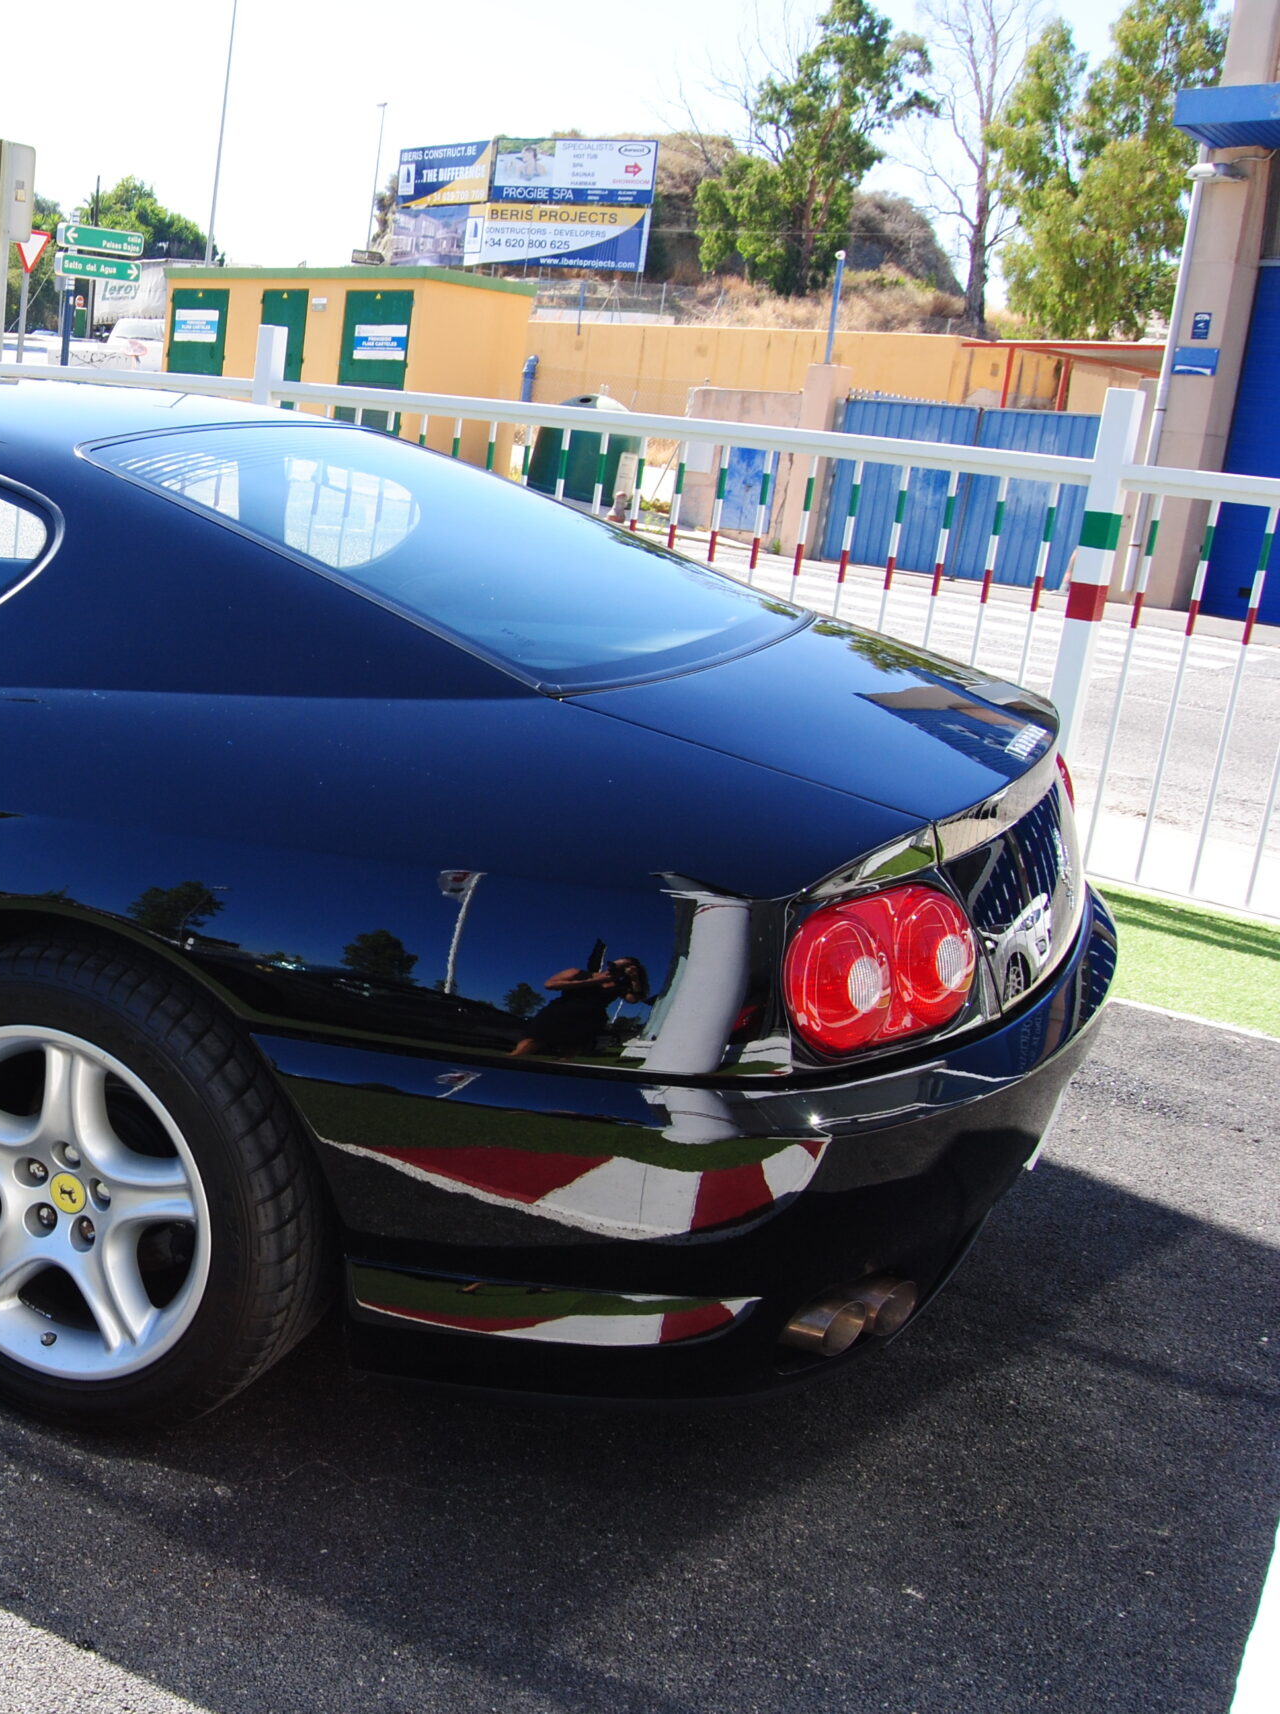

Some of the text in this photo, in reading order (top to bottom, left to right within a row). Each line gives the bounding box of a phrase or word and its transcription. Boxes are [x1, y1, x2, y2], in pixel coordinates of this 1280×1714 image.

[401, 145, 478, 162] IBERIS CONSTRUCT.BE
[561, 143, 615, 152] SPECIALISTS
[438, 164, 487, 182] DIFFERENCE
[502, 186, 574, 201] PROGIBE SPA
[538, 209, 619, 224] PROJECTS
[553, 228, 607, 238] DEVELOPERS
[484, 238, 570, 250] +34 620 800 625
[64, 260, 117, 275] Salto del Agua
[101, 280, 141, 302] Leroy
